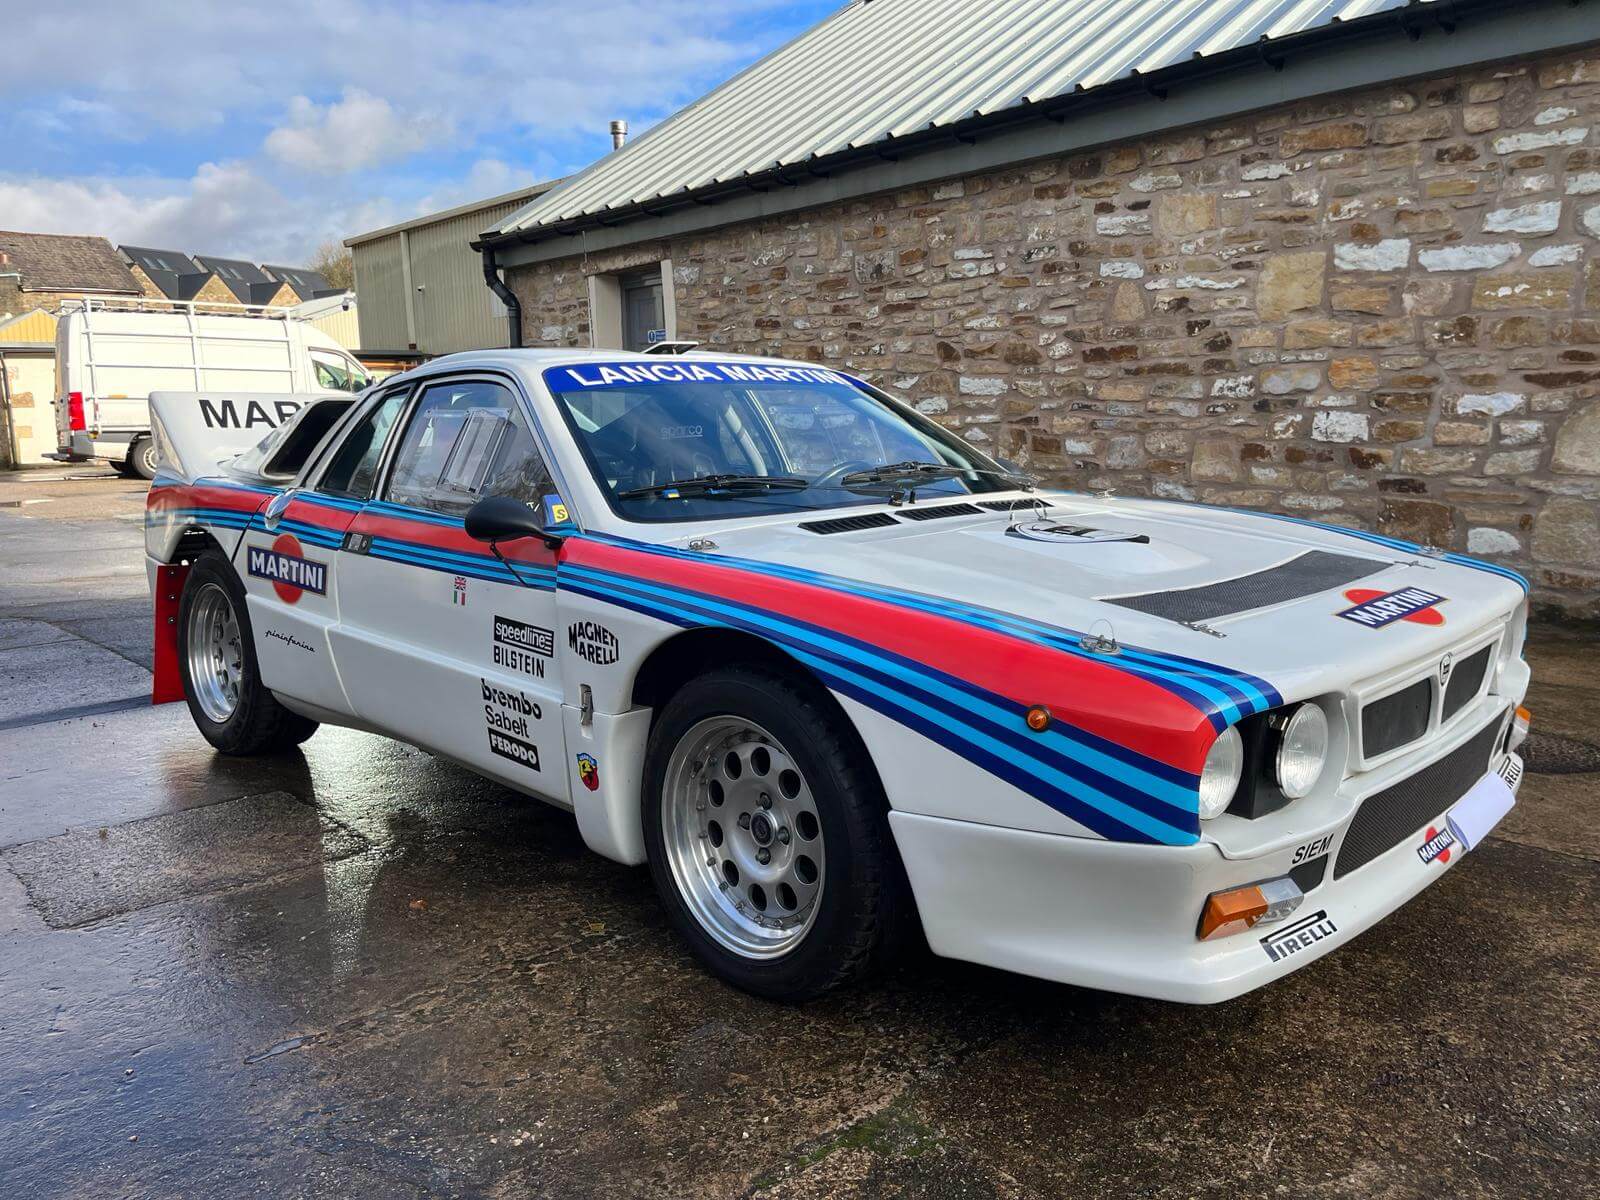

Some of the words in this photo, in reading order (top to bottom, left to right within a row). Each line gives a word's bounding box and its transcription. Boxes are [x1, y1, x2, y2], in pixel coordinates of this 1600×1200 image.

[566, 365, 721, 386] LANCIA
[199, 399, 312, 429] MAR
[251, 550, 323, 590] MARTINI
[1346, 589, 1439, 625] MARTINI
[495, 622, 546, 649] speedline
[568, 621, 619, 652] MAGNETI
[494, 645, 545, 679] BILSTEIN
[480, 678, 543, 720] brembo
[485, 704, 530, 739] Sabelt
[490, 733, 537, 765] FERODO
[1292, 833, 1335, 865] SIEM
[1419, 830, 1453, 862] MARTINI
[1259, 909, 1338, 963] PIRELLI
